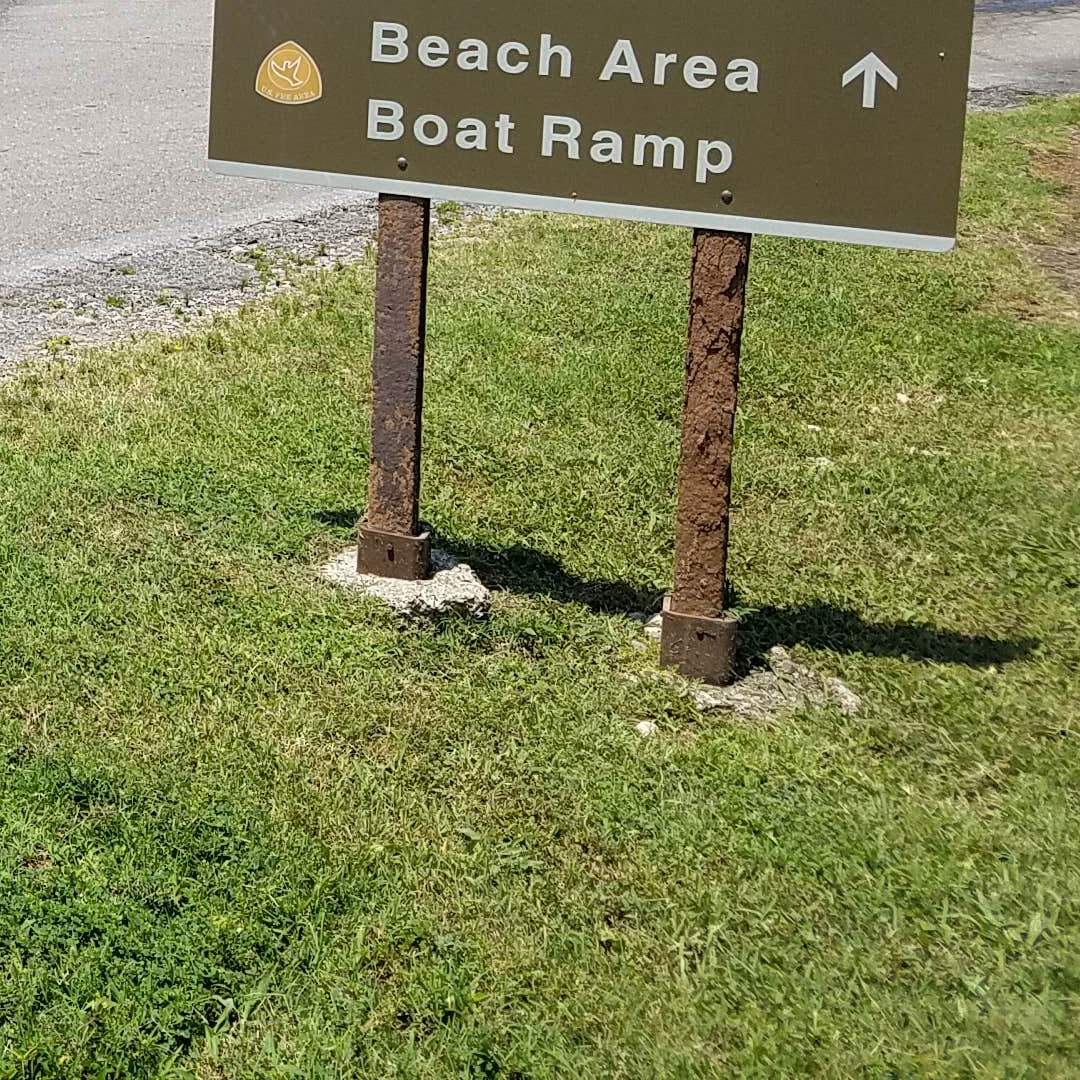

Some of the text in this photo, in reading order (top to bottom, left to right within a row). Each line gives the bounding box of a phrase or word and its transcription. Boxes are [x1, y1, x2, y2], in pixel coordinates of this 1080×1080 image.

[371, 21, 759, 93] Beach Area
[366, 98, 733, 184] Boat Ramp
